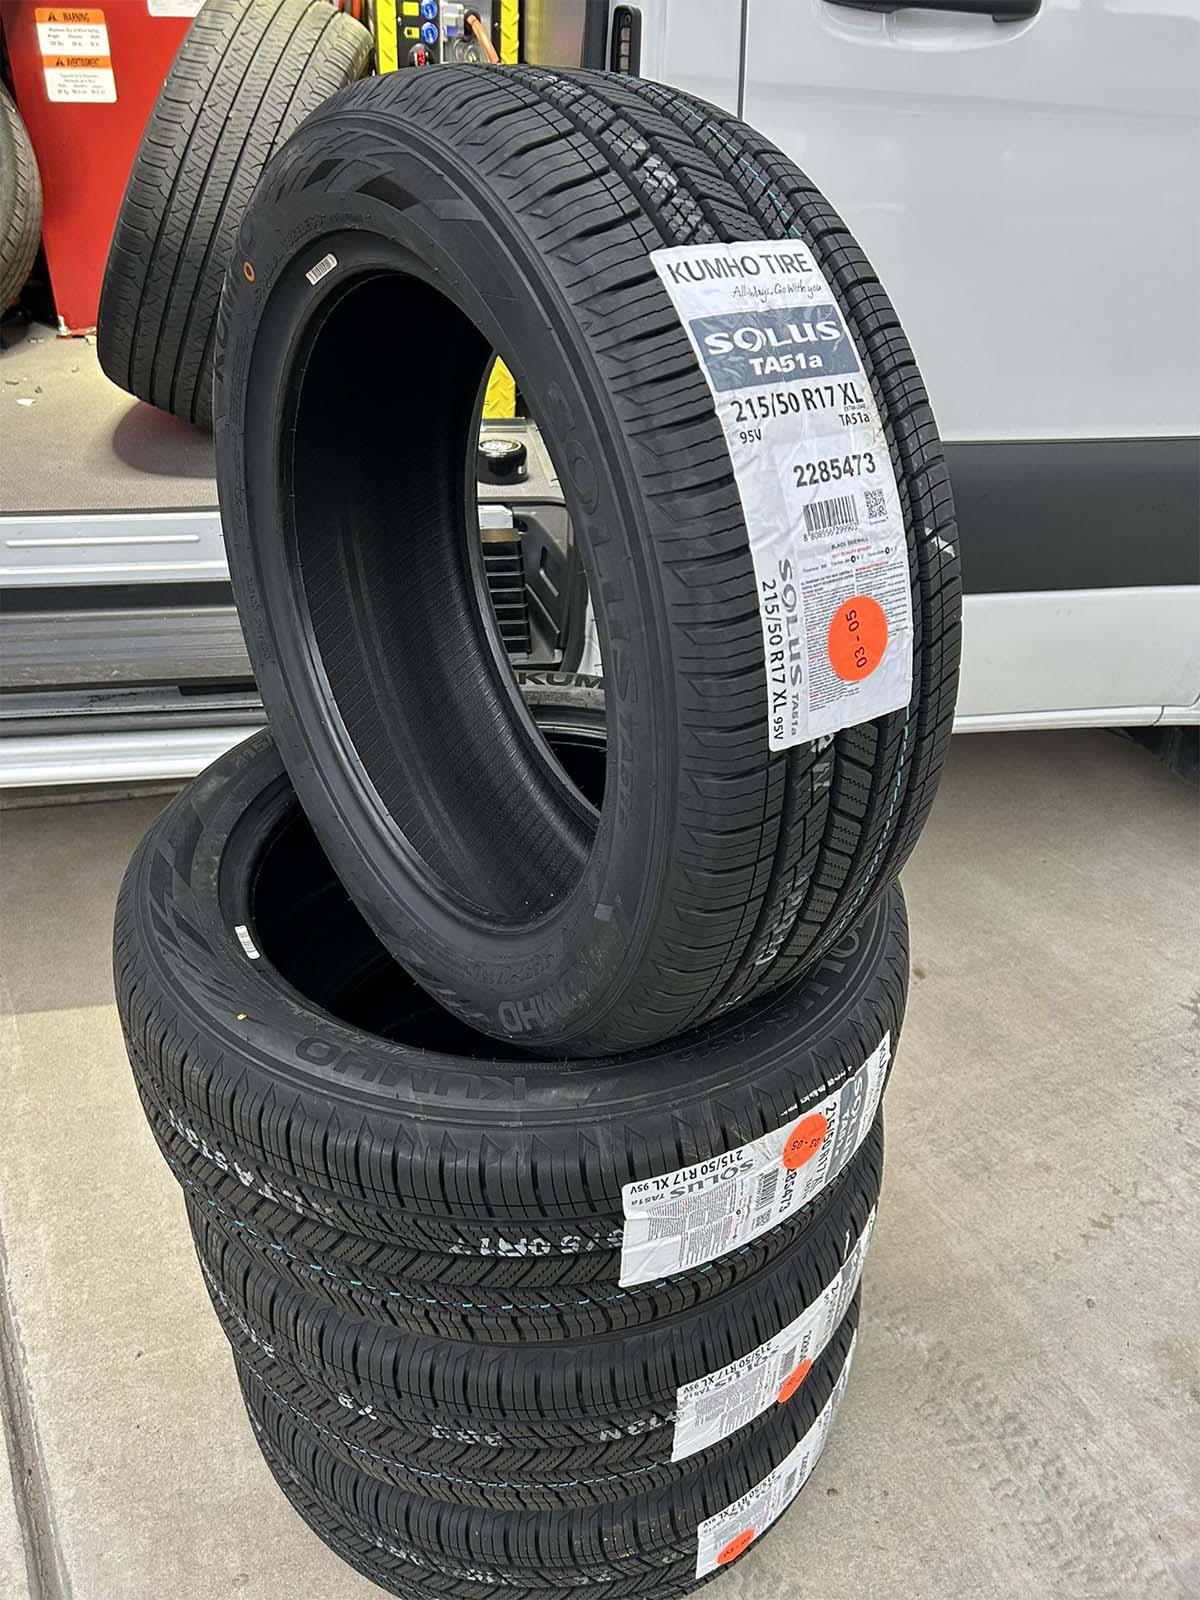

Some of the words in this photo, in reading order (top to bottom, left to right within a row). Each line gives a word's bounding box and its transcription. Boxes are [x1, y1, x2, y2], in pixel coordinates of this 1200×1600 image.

[666, 259, 761, 284] KUMHO
[760, 252, 813, 275] TIRE
[703, 320, 841, 355] SOLUS
[749, 353, 823, 376] TA51a
[730, 389, 801, 423] 215/50
[801, 385, 835, 411] R17
[837, 382, 864, 405] XL
[838, 412, 871, 426] TA51a
[739, 428, 762, 445] 95V
[793, 452, 877, 488] 2285473
[762, 580, 784, 646] 215/50
[779, 558, 803, 687] SOLUS
[845, 609, 860, 632] 05
[770, 650, 786, 684] R17
[854, 646, 868, 668] 03
[772, 688, 787, 714] XL
[790, 693, 800, 736] TA51a
[773, 716, 784, 740] 95V
[672, 1166, 698, 1182] R17
[701, 1149, 744, 1175] 215/50
[630, 1182, 650, 1195] 95V
[652, 1176, 670, 1190] XL
[670, 1158, 754, 1200] SOLUS
[738, 1341, 772, 1369] 215/50
[698, 1375, 715, 1388] XL
